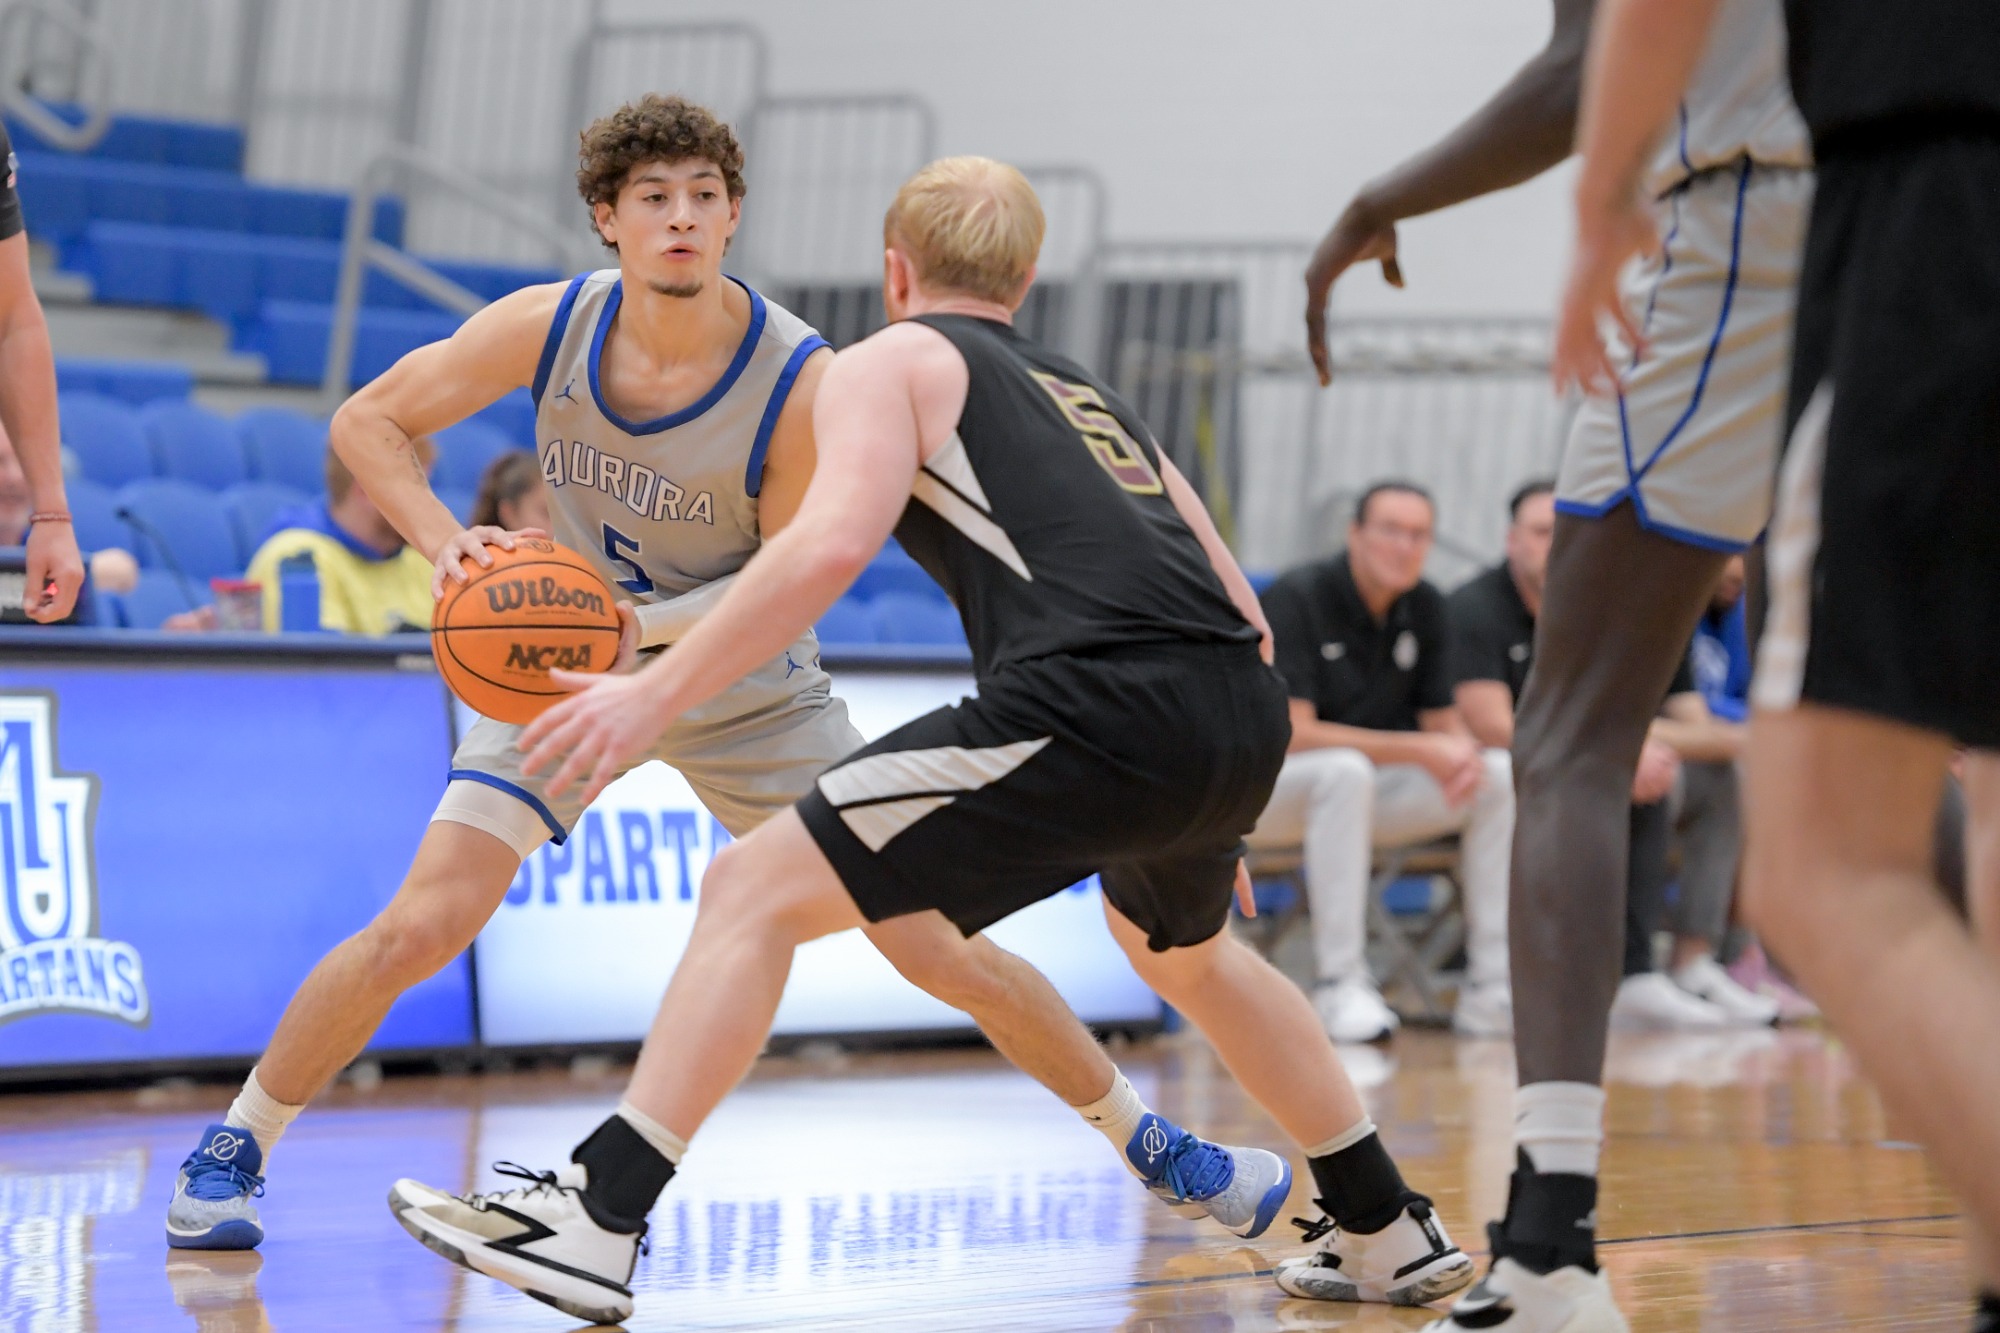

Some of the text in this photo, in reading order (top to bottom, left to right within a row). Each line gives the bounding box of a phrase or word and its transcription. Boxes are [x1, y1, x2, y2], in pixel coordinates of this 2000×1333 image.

[1026, 368, 1164, 495] 5
[542, 439, 714, 525] AURORA
[601, 519, 656, 597] 5
[485, 577, 607, 617] Wilson
[505, 643, 594, 672] NCAA
[0, 949, 140, 1012] RTANS
